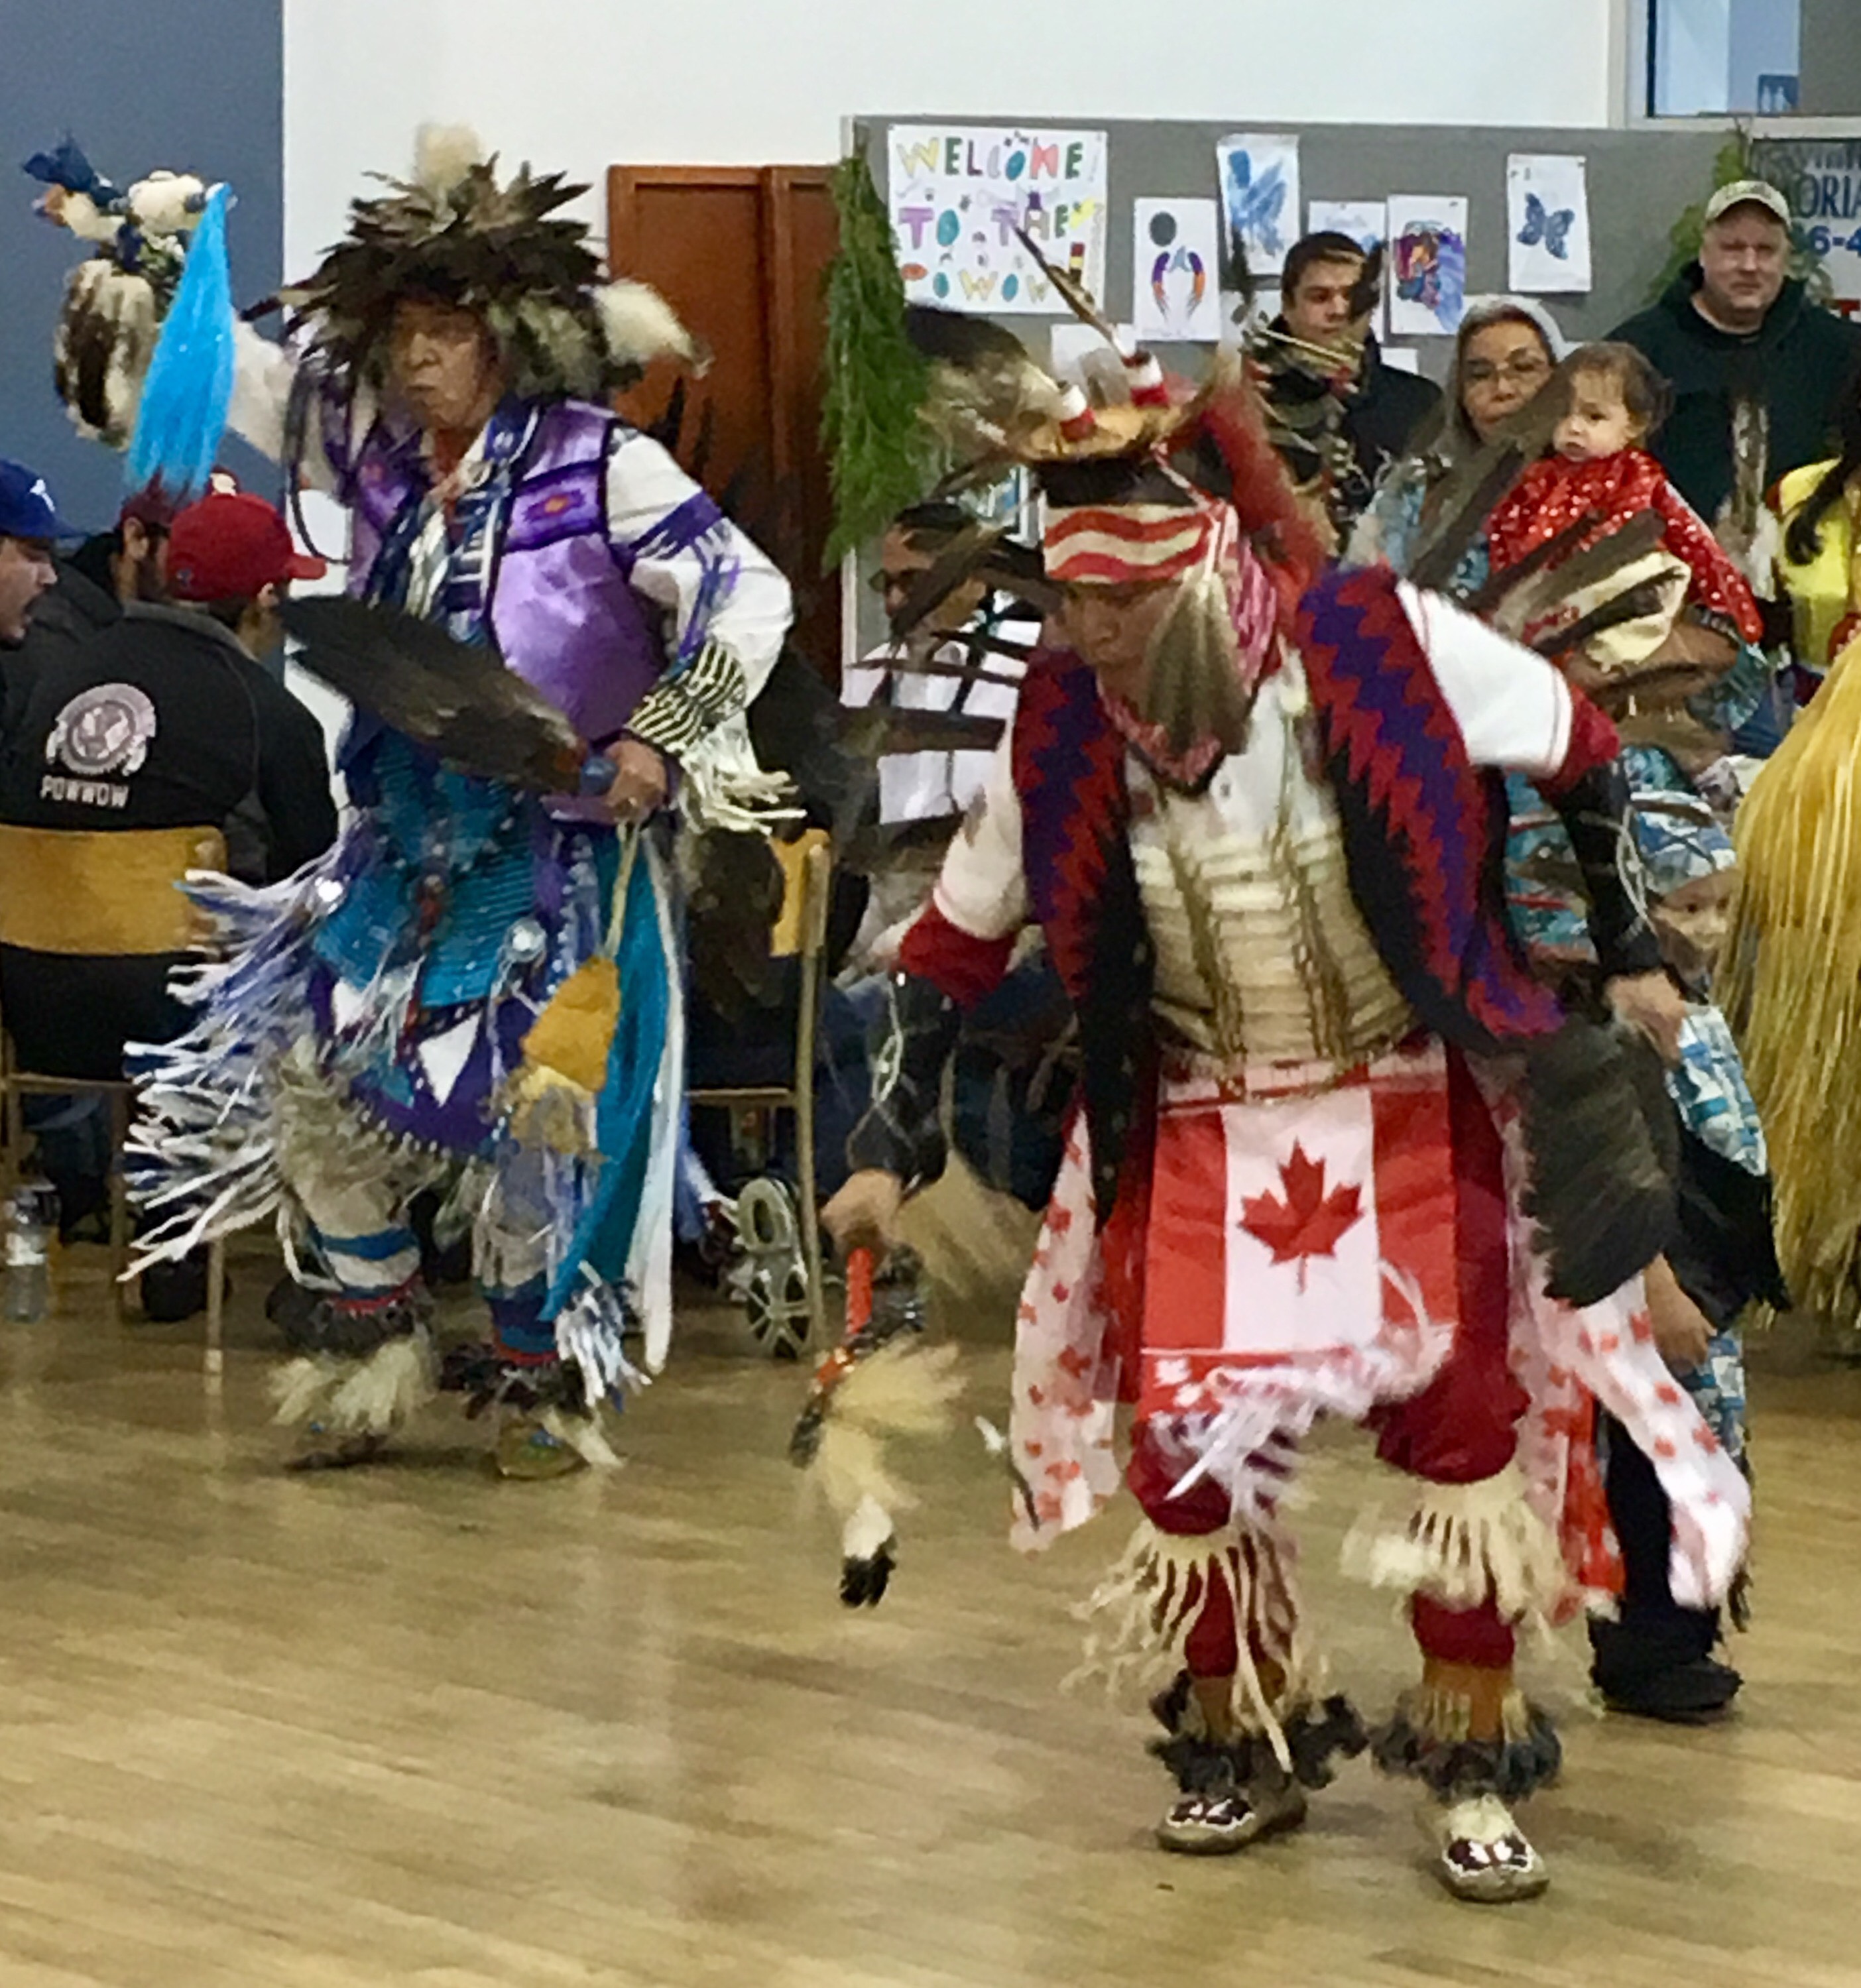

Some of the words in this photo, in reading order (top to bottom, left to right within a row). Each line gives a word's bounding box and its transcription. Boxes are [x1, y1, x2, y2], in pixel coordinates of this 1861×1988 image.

[897, 137, 1083, 180] WELCOME
[898, 207, 960, 249] TO
[991, 204, 1069, 247] THE
[40, 774, 129, 807] POWWOW
